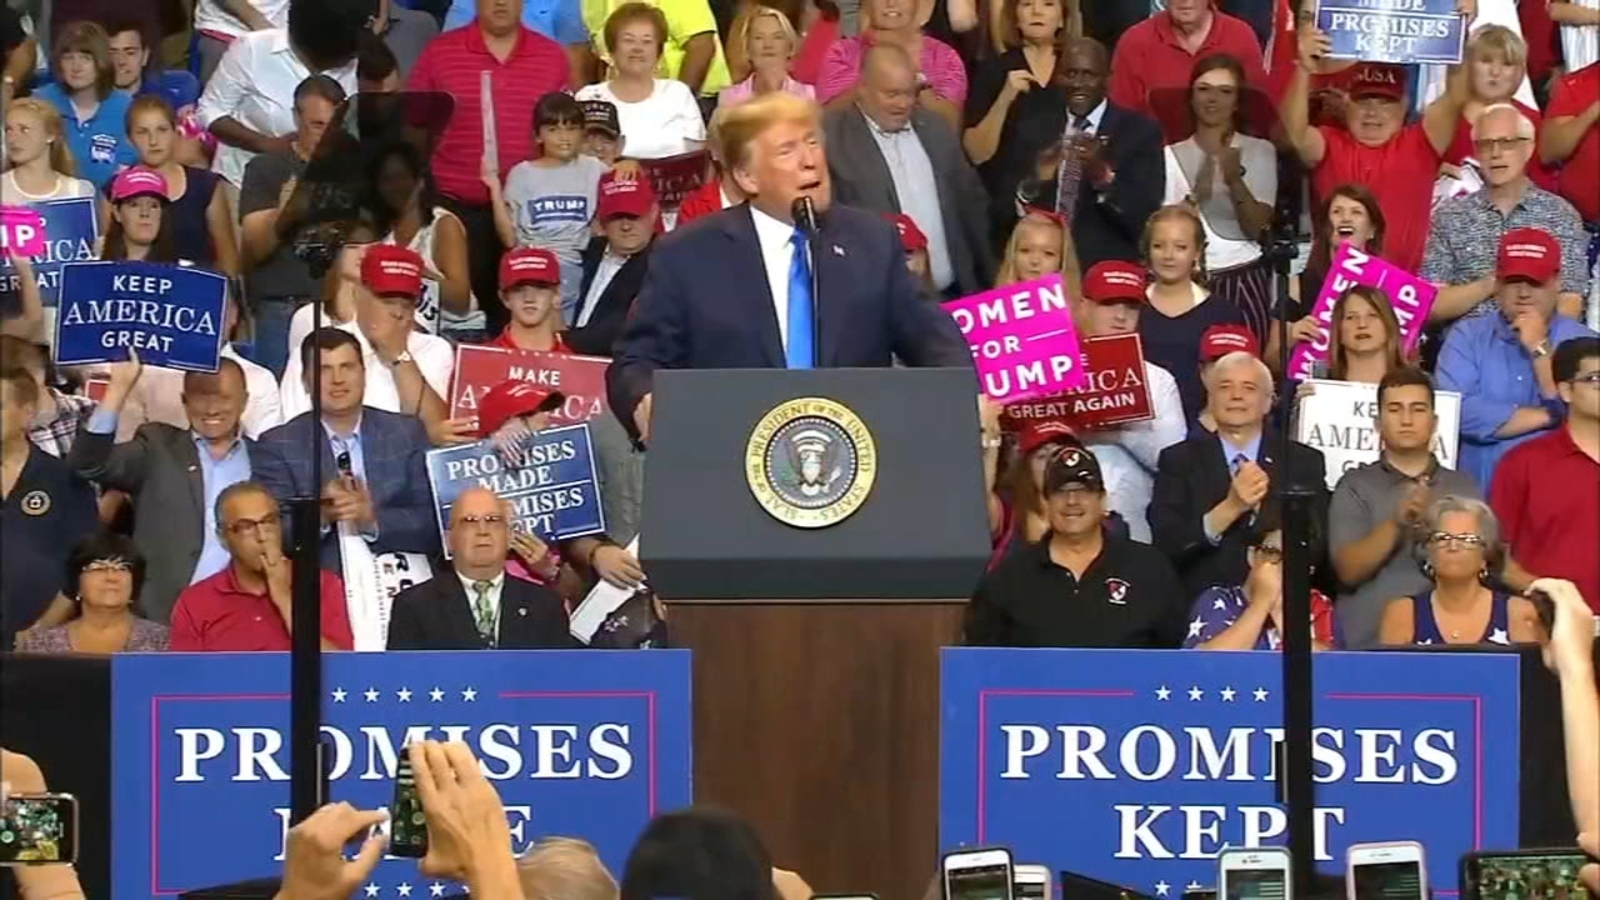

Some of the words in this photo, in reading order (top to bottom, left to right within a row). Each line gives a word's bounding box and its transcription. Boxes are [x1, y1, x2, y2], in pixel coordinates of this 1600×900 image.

[113, 275, 173, 294] KEEP
[63, 300, 216, 335] AMERICA
[951, 284, 1067, 334] OMEN
[101, 330, 173, 352] GREAT
[508, 366, 560, 386] MAKE
[985, 355, 1072, 397] UMP
[1009, 402, 1068, 419] GREAT
[1073, 392, 1136, 413] AGAIN
[751, 403, 810, 458] PRESIDENT
[846, 419, 872, 473] UNITED
[446, 440, 576, 480] PROISES
[478, 465, 553, 493] MADE
[820, 483, 866, 521] STATES
